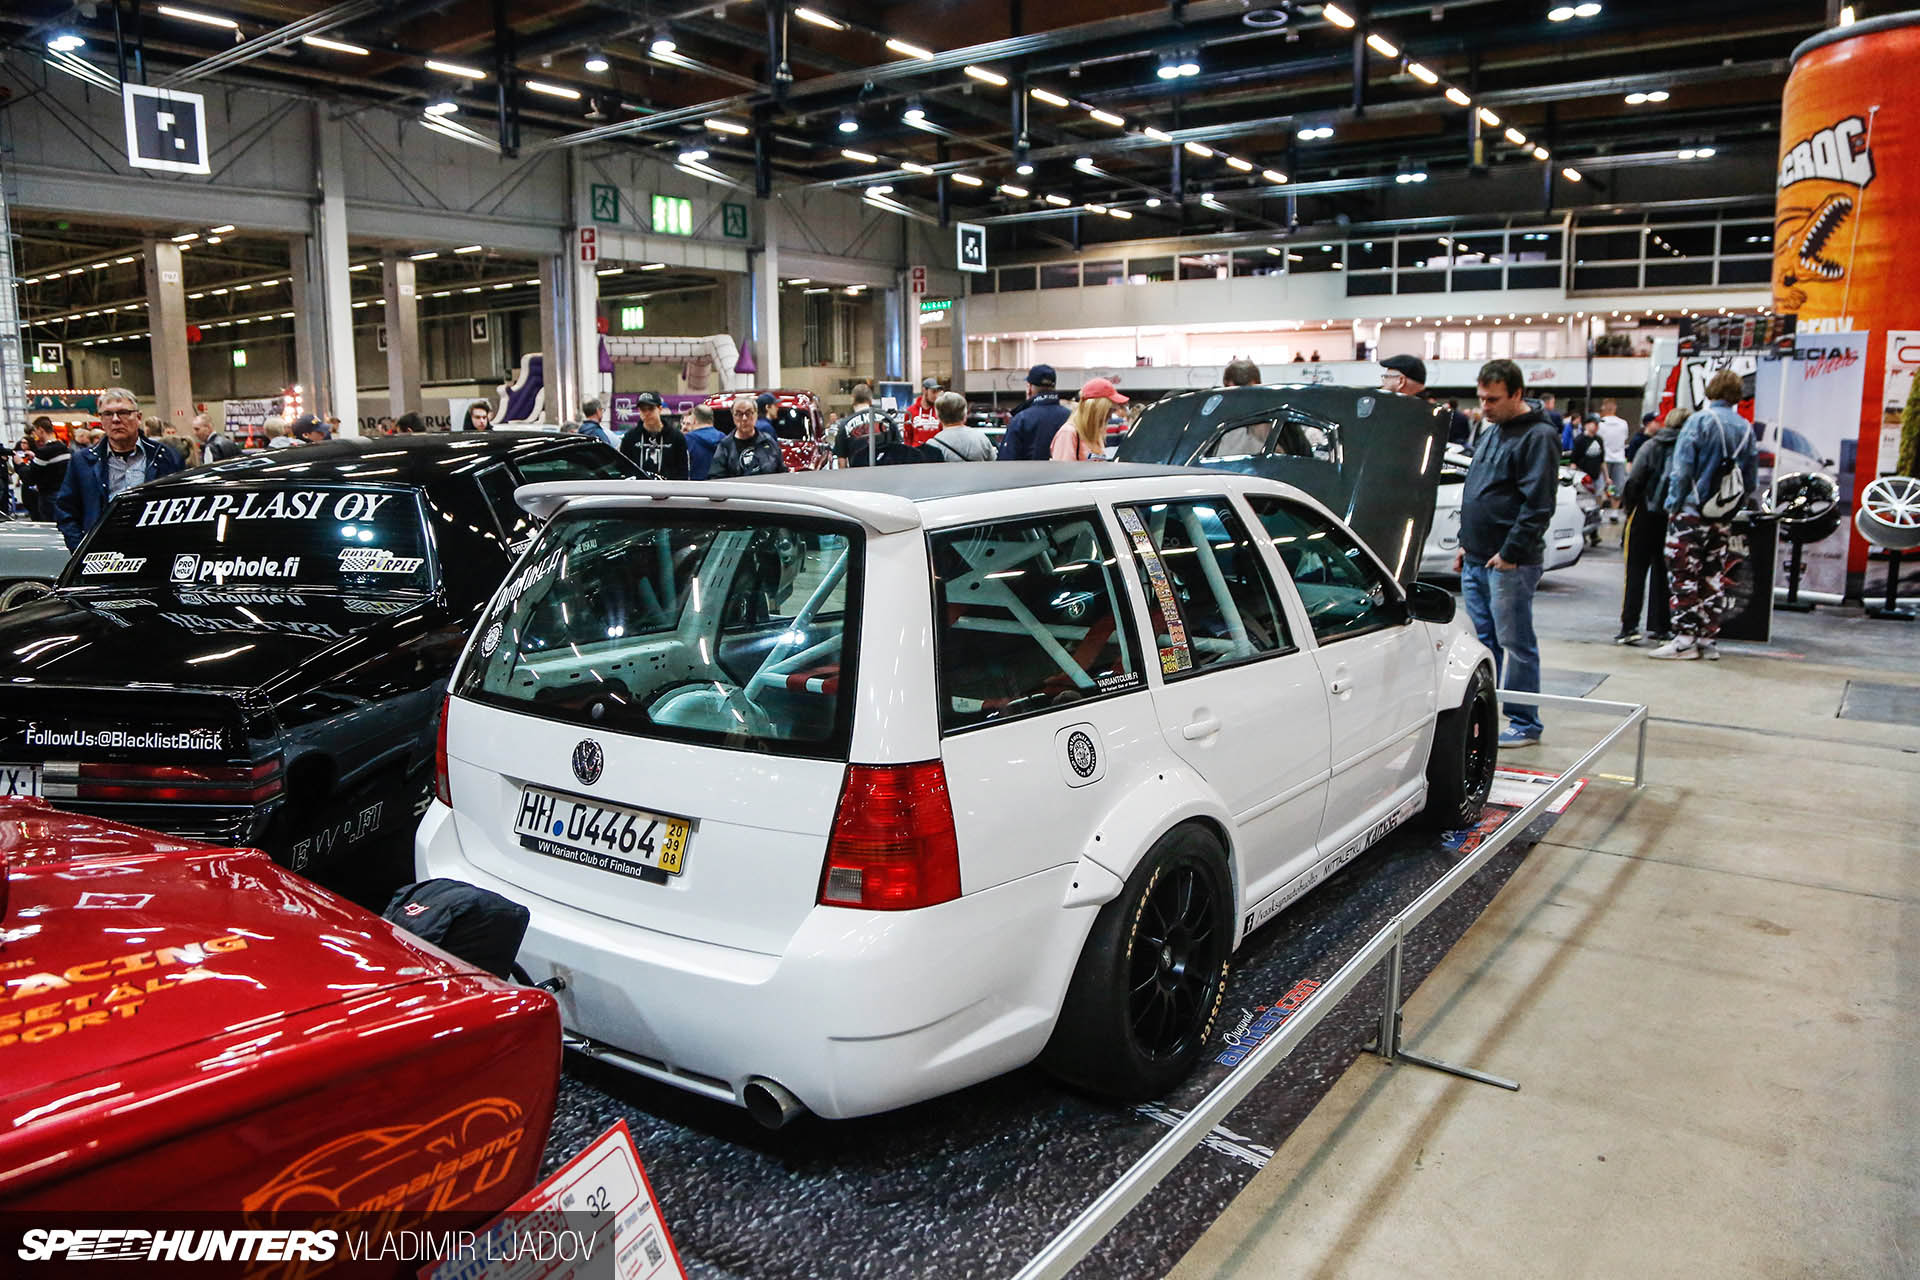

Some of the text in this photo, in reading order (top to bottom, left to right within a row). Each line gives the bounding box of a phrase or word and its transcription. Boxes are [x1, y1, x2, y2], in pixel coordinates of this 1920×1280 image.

[135, 491, 393, 527] HELP-LASI OY
[84, 553, 115, 562] ROYAL
[341, 549, 379, 557] ROYAL
[101, 559, 143, 572] PURPLE
[198, 556, 301, 581] prohole.fi
[364, 559, 418, 571] PURPLE
[26, 729, 223, 750] FollowUs:@BlacklistBuick
[518, 791, 660, 859] HH 04464
[669, 824, 684, 837] 20
[666, 838, 680, 851] 09
[538, 840, 642, 876] VW Variant Club of Finland
[662, 852, 677, 865] 08
[1223, 1007, 1255, 1047] Original
[586, 1186, 611, 1218] 32
